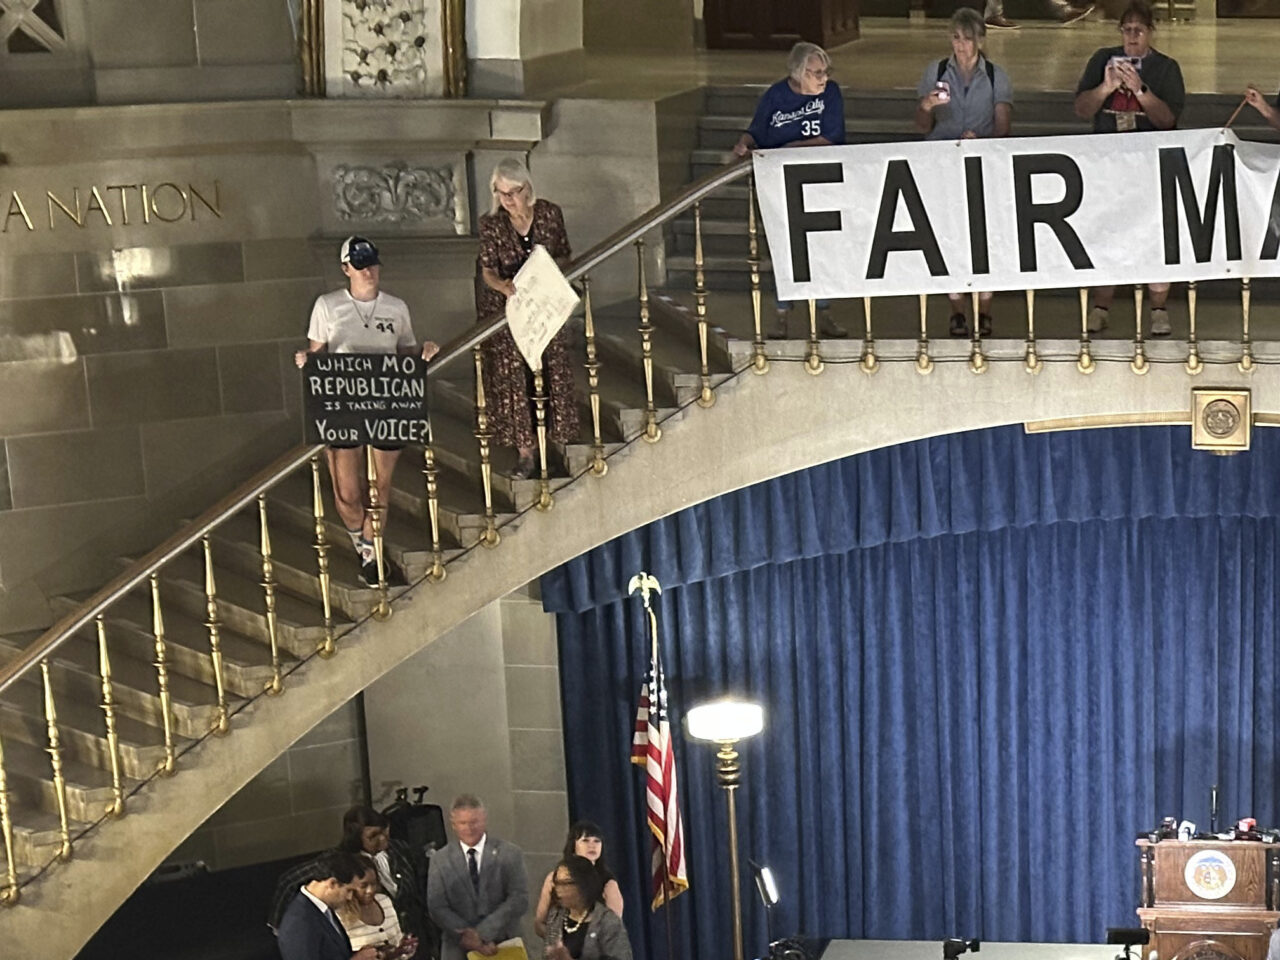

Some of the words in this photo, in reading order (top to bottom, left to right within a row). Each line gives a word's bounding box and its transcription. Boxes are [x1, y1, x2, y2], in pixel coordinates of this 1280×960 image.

[770, 108, 804, 126] Kansas
[805, 98, 825, 114] City
[801, 120, 821, 136] 35
[2, 190, 34, 232] A
[47, 180, 223, 230] NATION
[783, 153, 1095, 283] FAIR
[375, 322, 396, 334] 44
[317, 357, 372, 372] WHICH
[382, 356, 415, 374] MO
[309, 376, 425, 398] REPUBLICAN
[324, 401, 341, 410] IS
[346, 401, 387, 410] TAKING
[391, 401, 424, 409] AWAY
[364, 418, 429, 443] VOICE?
